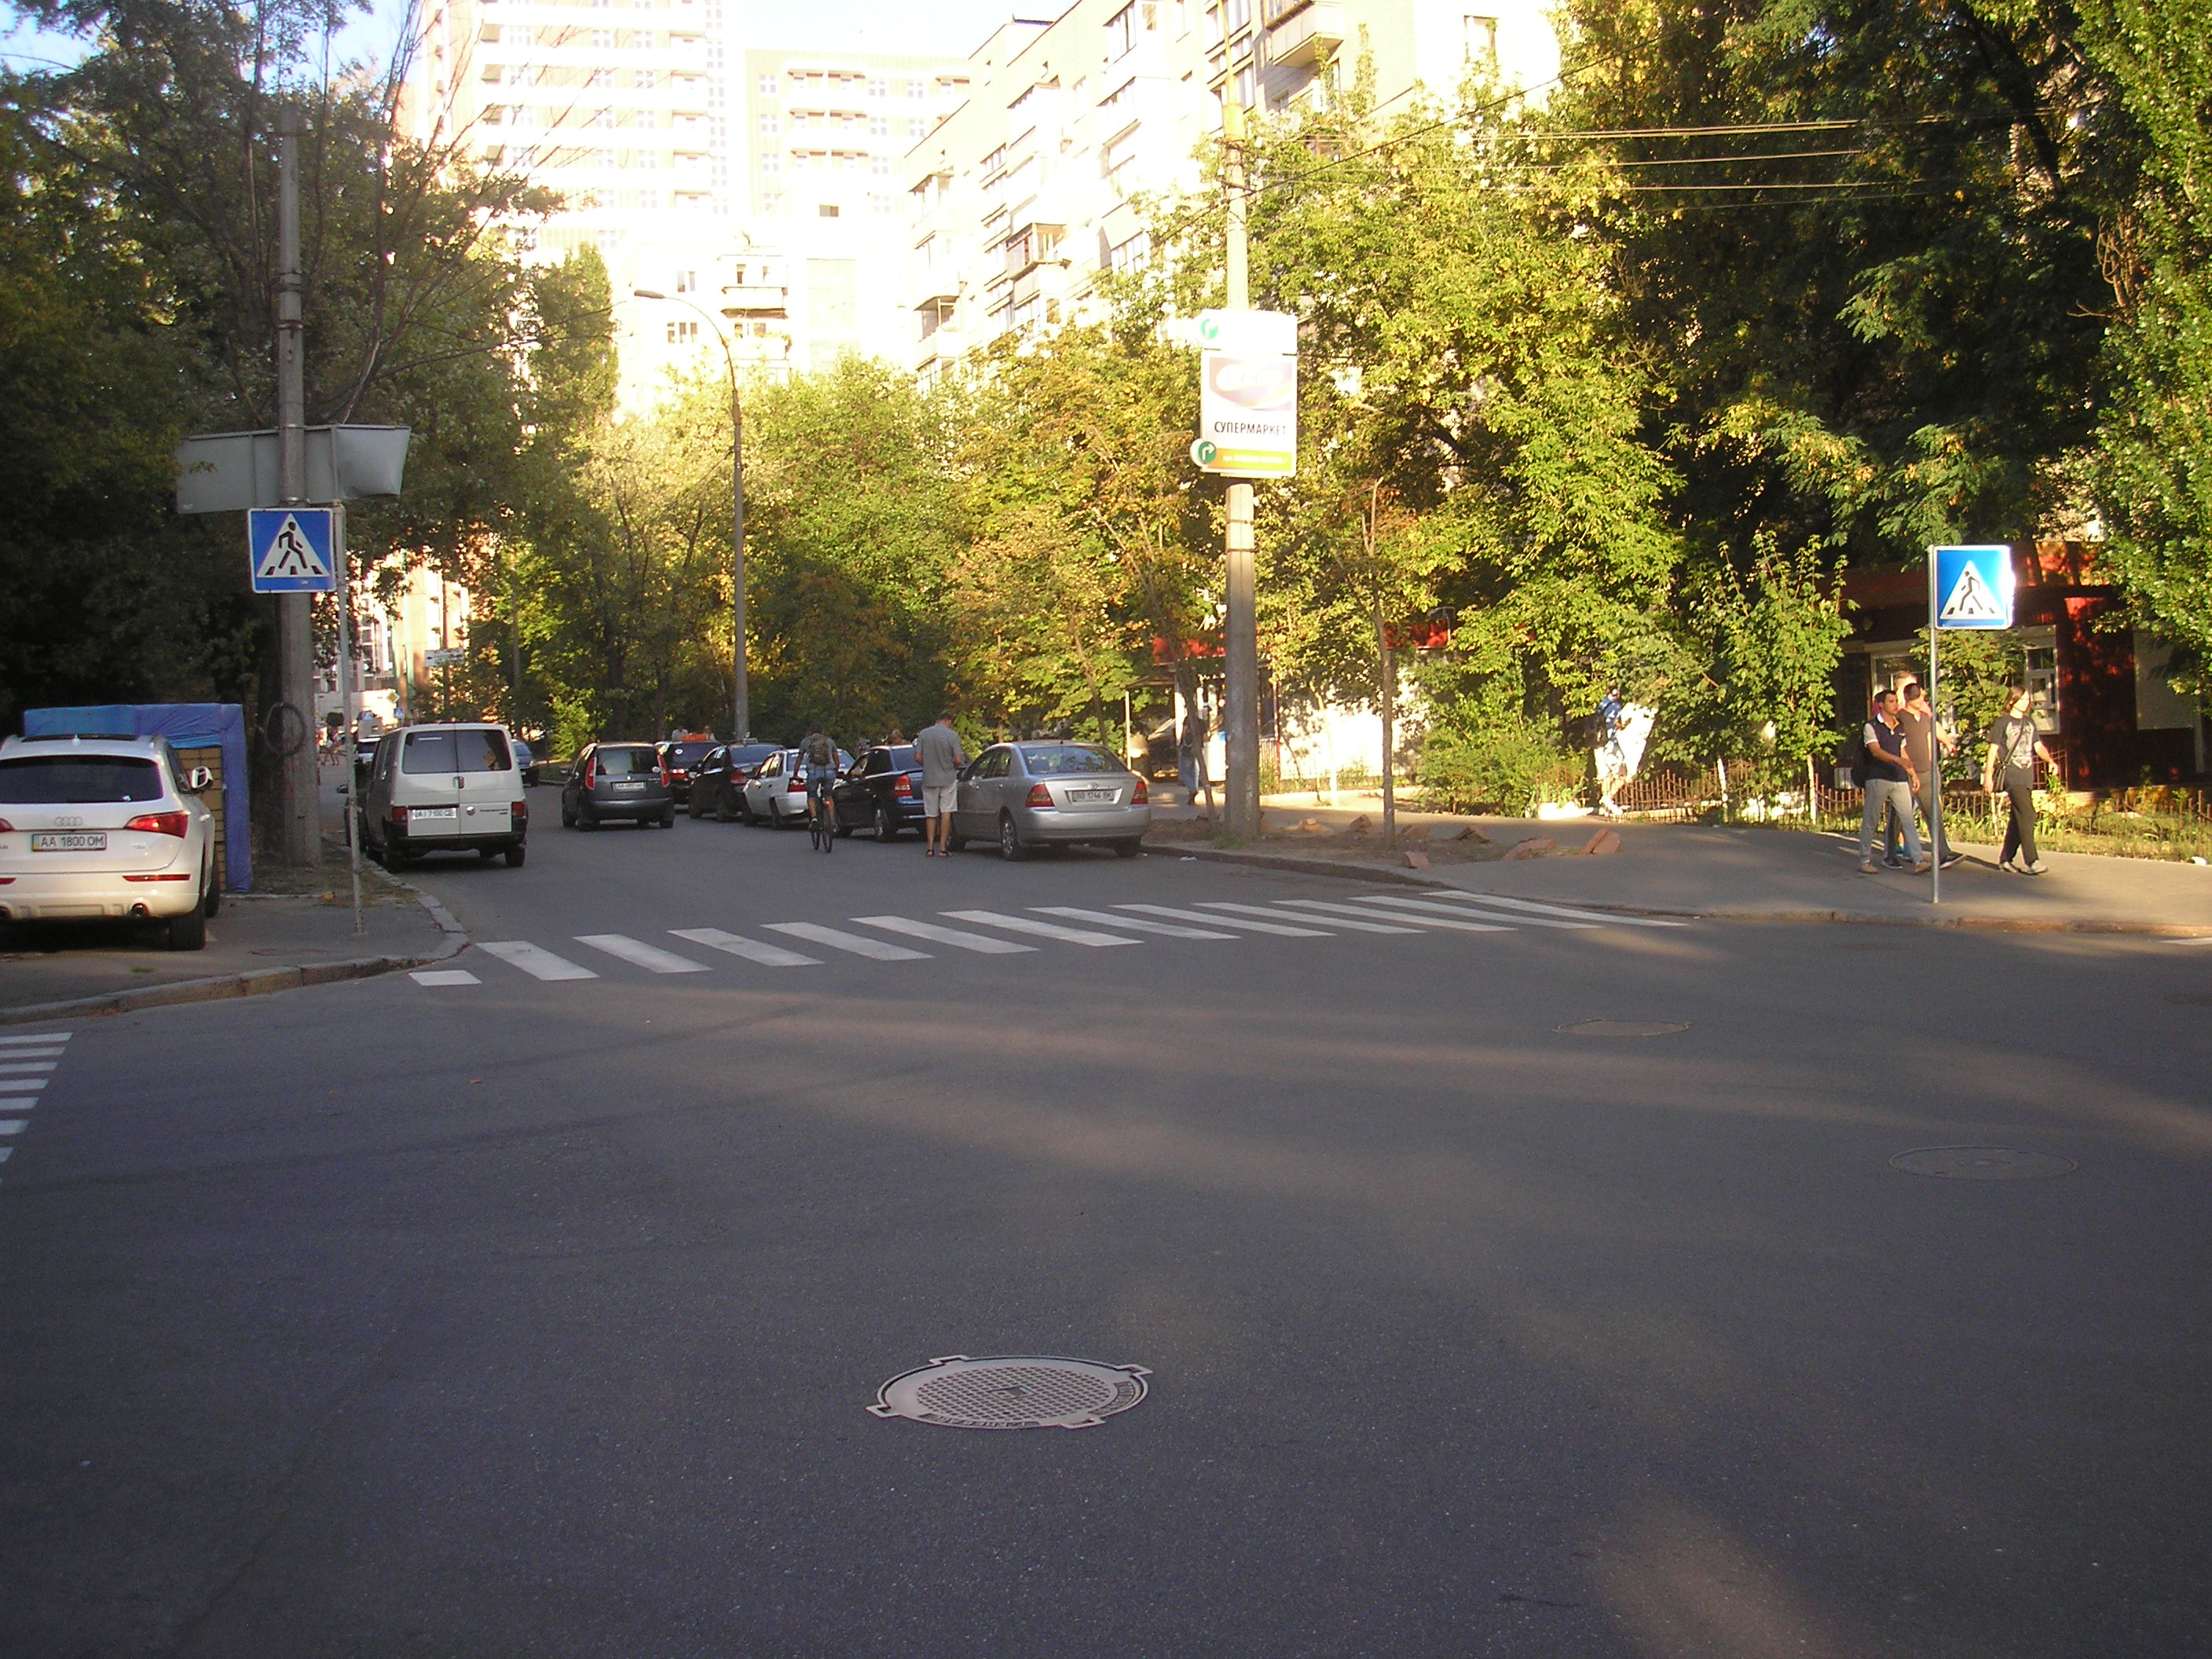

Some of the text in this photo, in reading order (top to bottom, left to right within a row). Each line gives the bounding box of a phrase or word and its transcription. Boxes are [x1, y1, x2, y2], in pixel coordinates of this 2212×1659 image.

[1214, 420, 1286, 435] СУПЕРМАРКЕТ
[42, 835, 104, 847] AA 1800 OM
